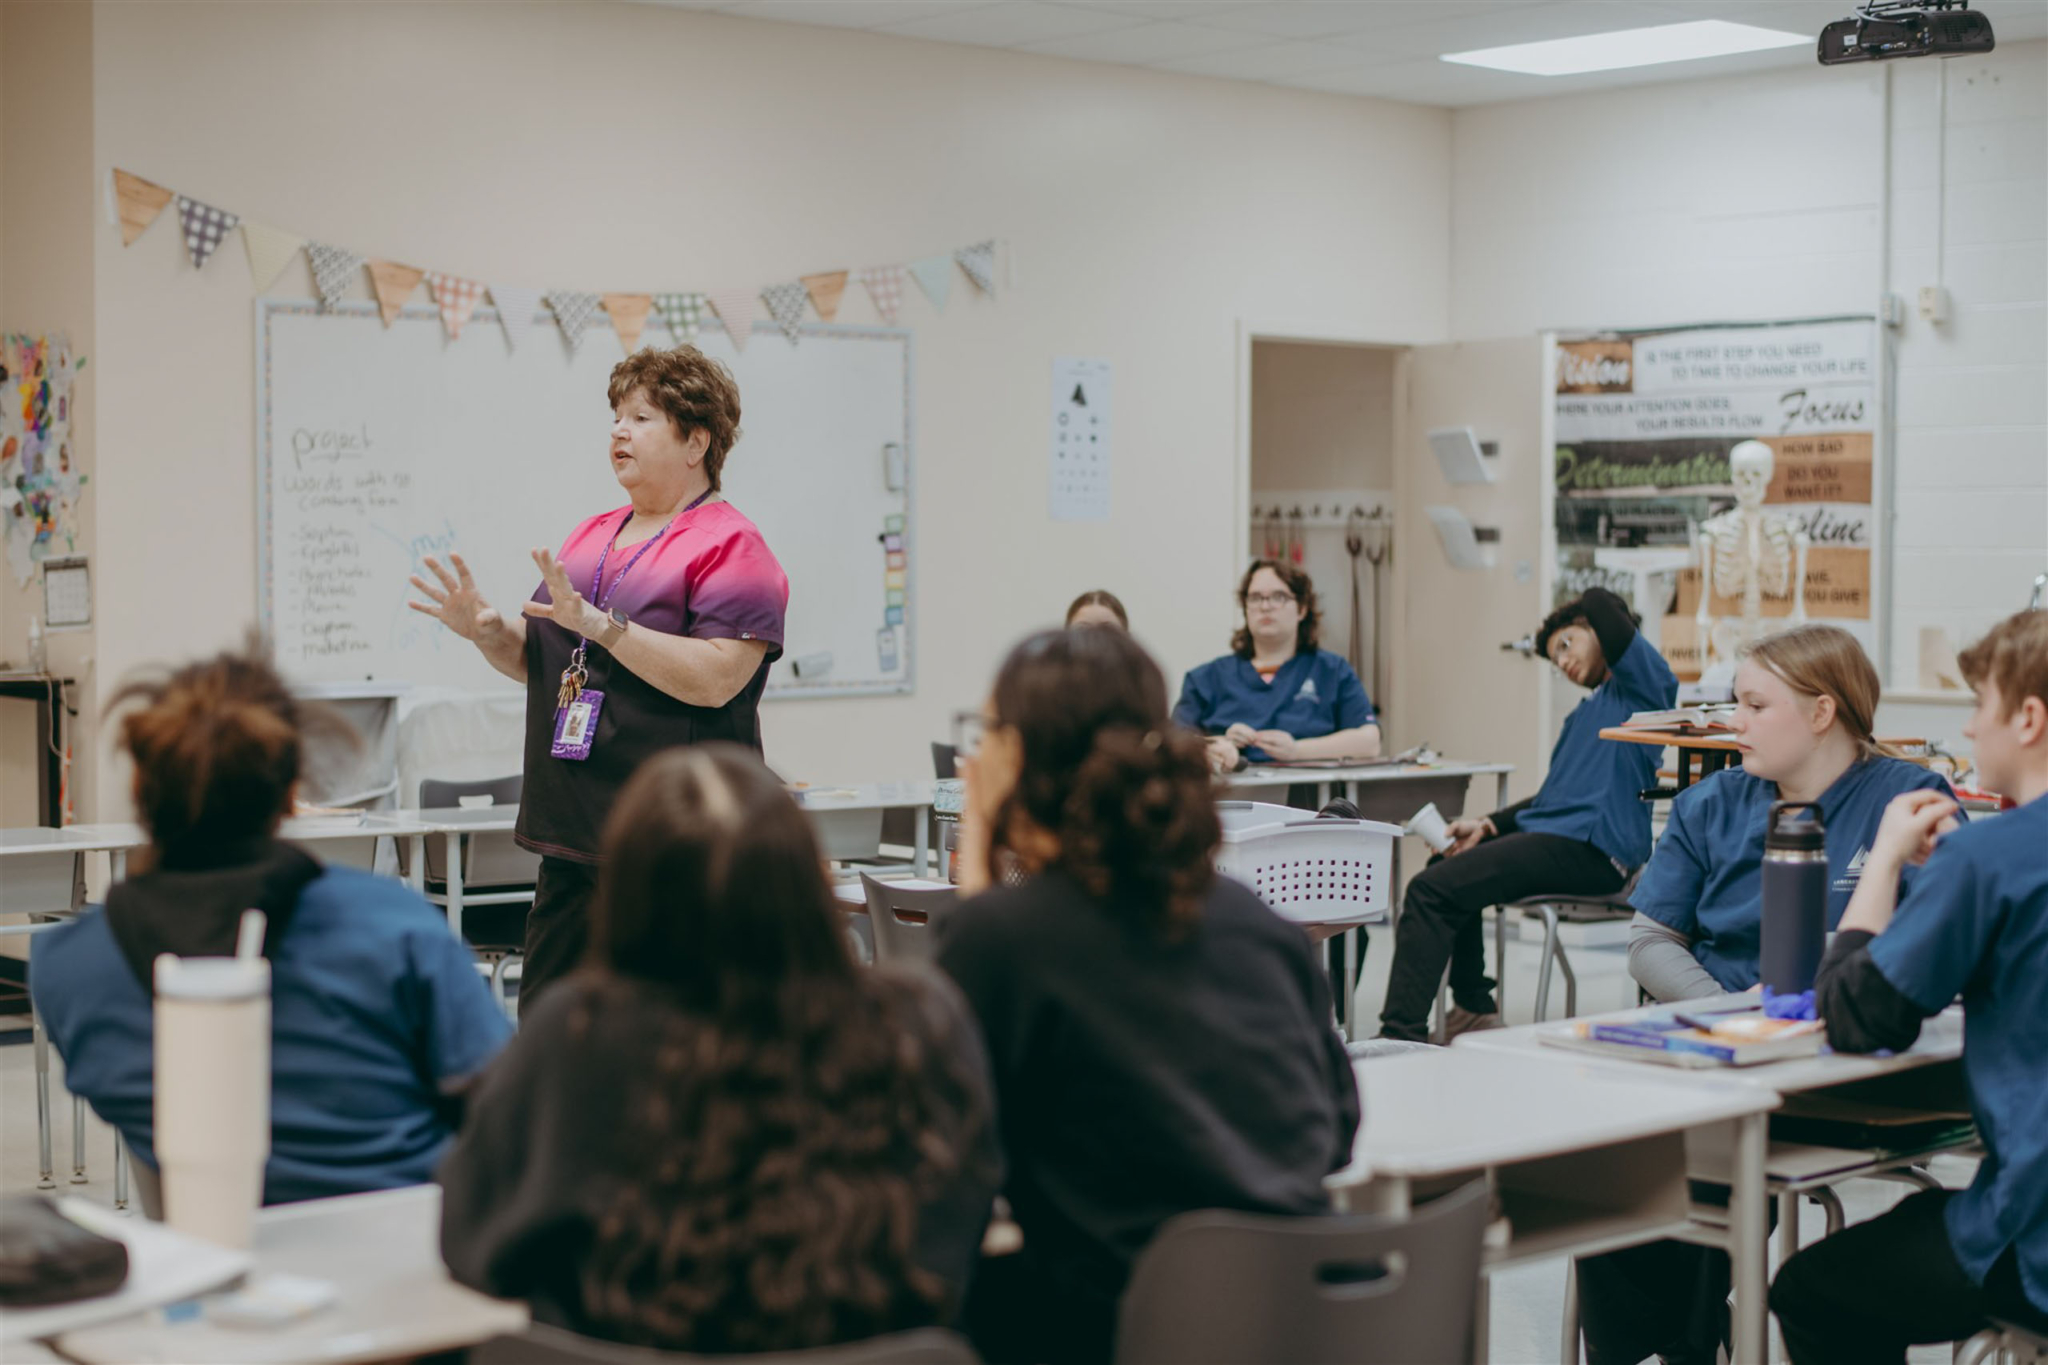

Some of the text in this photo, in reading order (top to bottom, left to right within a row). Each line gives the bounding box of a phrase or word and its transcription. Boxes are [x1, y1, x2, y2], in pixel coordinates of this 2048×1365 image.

[1660, 350, 1682, 361] THE
[1685, 348, 1716, 360] FIRST
[1723, 346, 1752, 359] STEP
[1756, 345, 1782, 358] YOU
[1786, 344, 1821, 356] NEED
[1672, 367, 1688, 379] TO
[1691, 365, 1722, 379] TAKE
[1725, 364, 1742, 378] TO
[1744, 363, 1797, 377] CHANGE
[1800, 361, 1837, 374] YOUR
[1556, 404, 1588, 416] HERE
[1591, 402, 1624, 414] YOUR
[1626, 399, 1692, 414] ATTENTION
[1779, 388, 1864, 435] Focus
[1636, 414, 1763, 431] YOUR RESULTS FLOW
[1782, 441, 1844, 455] HOW BAD
[1787, 465, 1839, 480] DO YOU
[1784, 485, 1822, 498] WANT
[1830, 588, 1860, 604] GIVE
